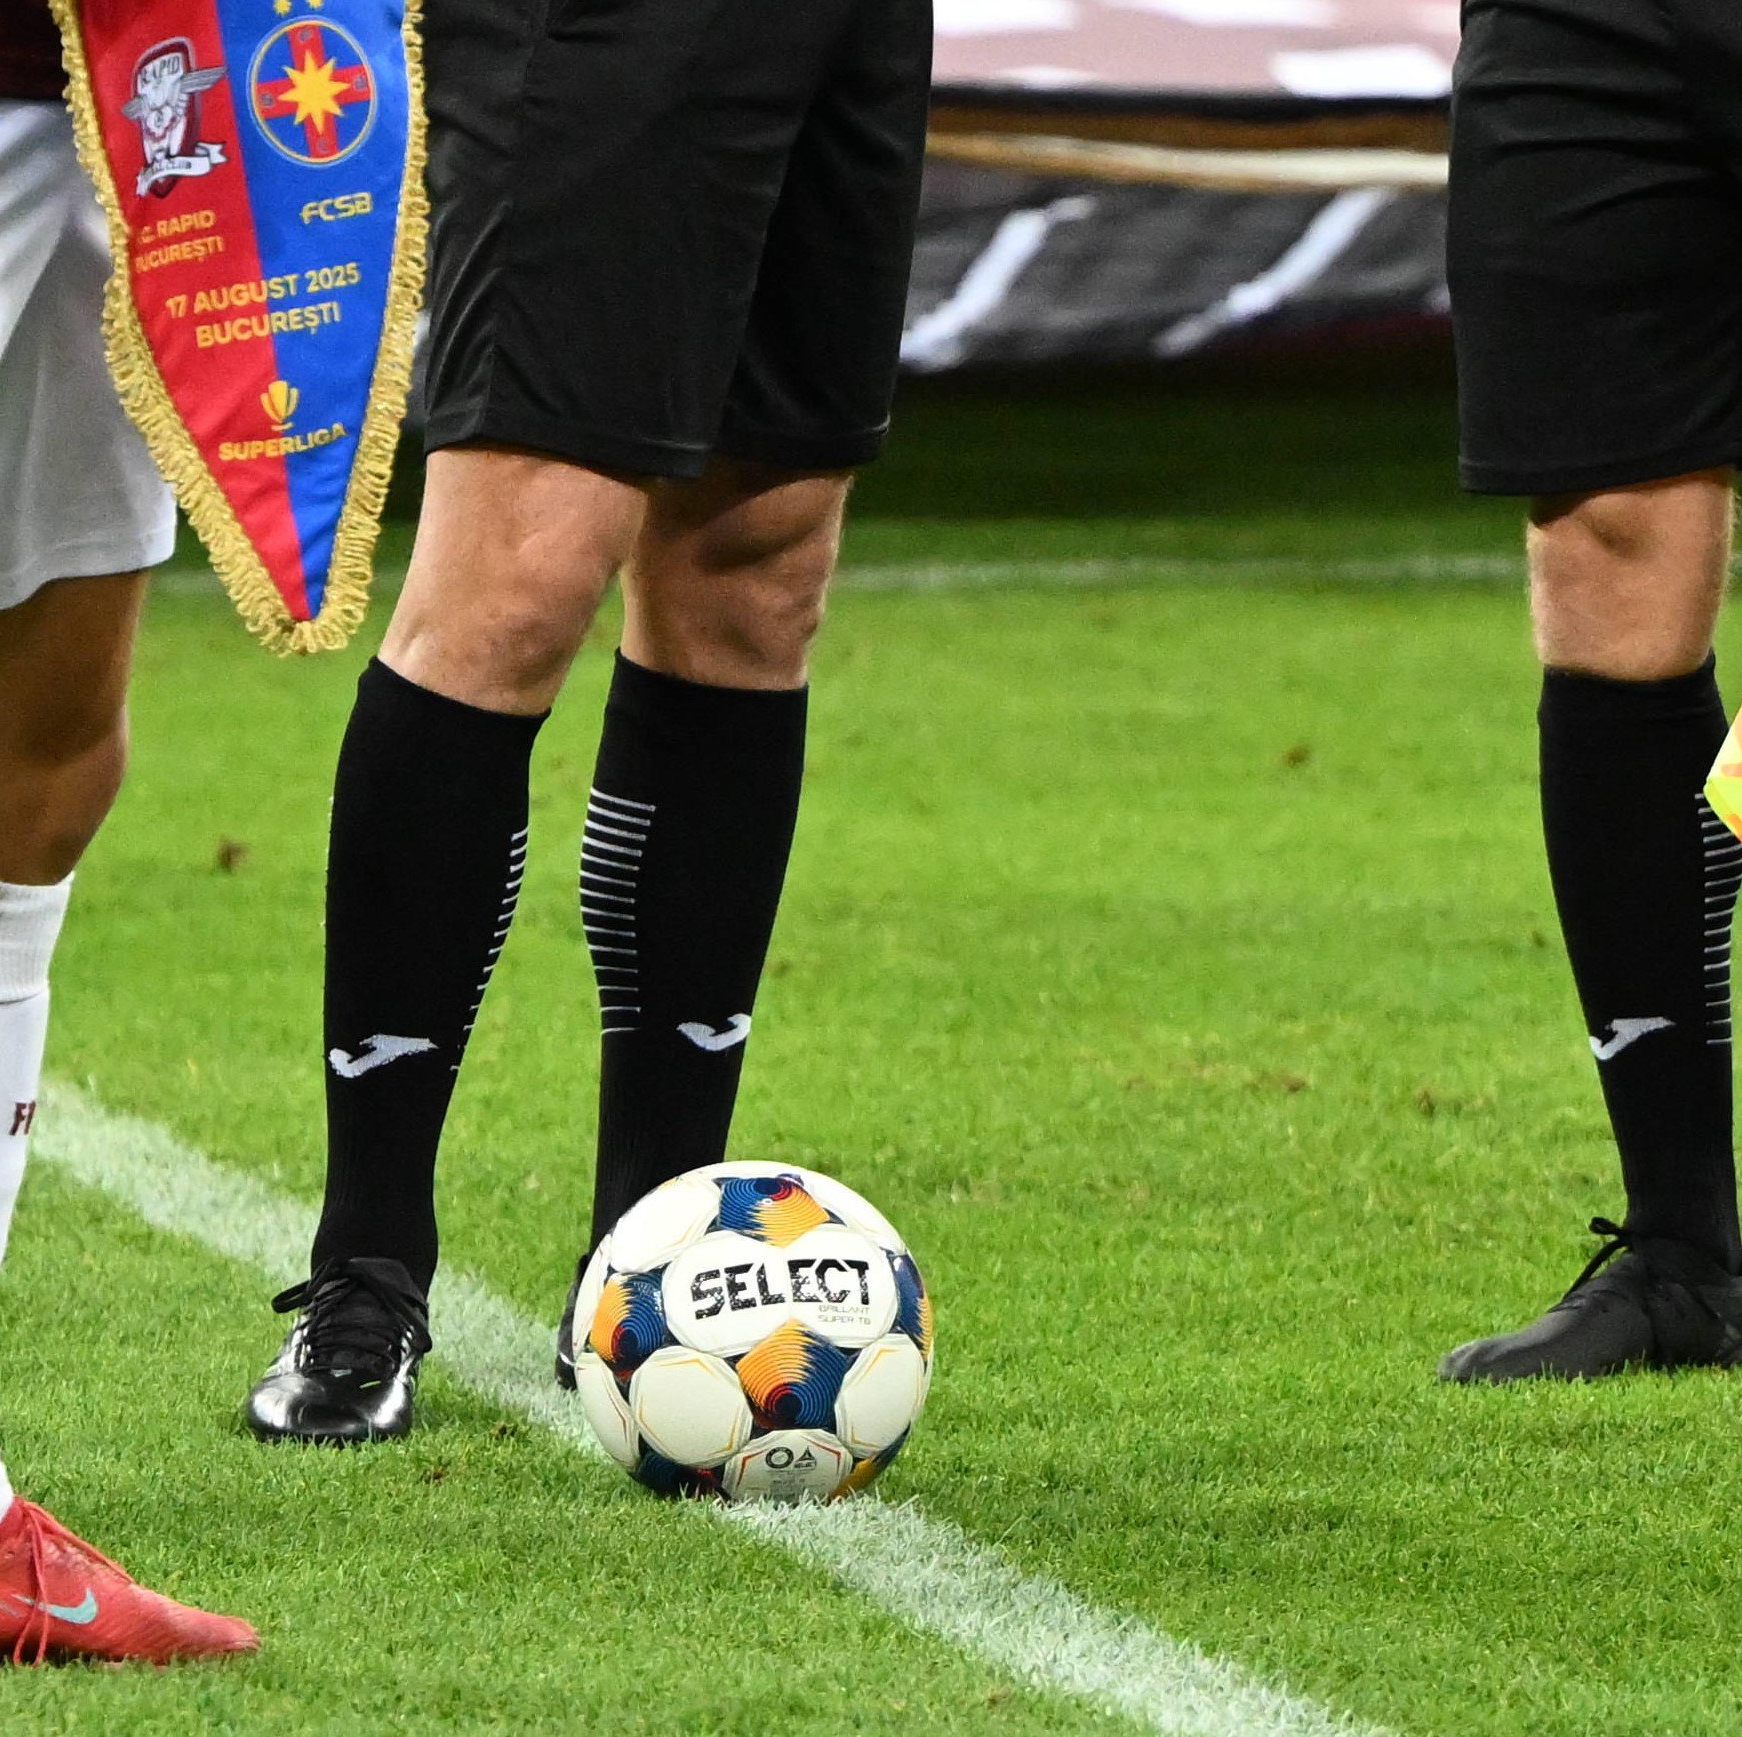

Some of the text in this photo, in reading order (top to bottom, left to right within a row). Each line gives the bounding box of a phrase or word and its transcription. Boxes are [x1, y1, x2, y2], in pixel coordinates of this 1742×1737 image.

[157, 209, 216, 238] RAPID
[300, 191, 373, 224] FCSB
[166, 262, 362, 319] 17 AUGUST 2025
[195, 301, 341, 349] BUCUREȘTI
[218, 422, 348, 461] SUPERLIGA
[689, 1258, 870, 1320] SELECT
[817, 1314, 854, 1324] SUPER
[818, 1304, 870, 1315] BRILLANT
